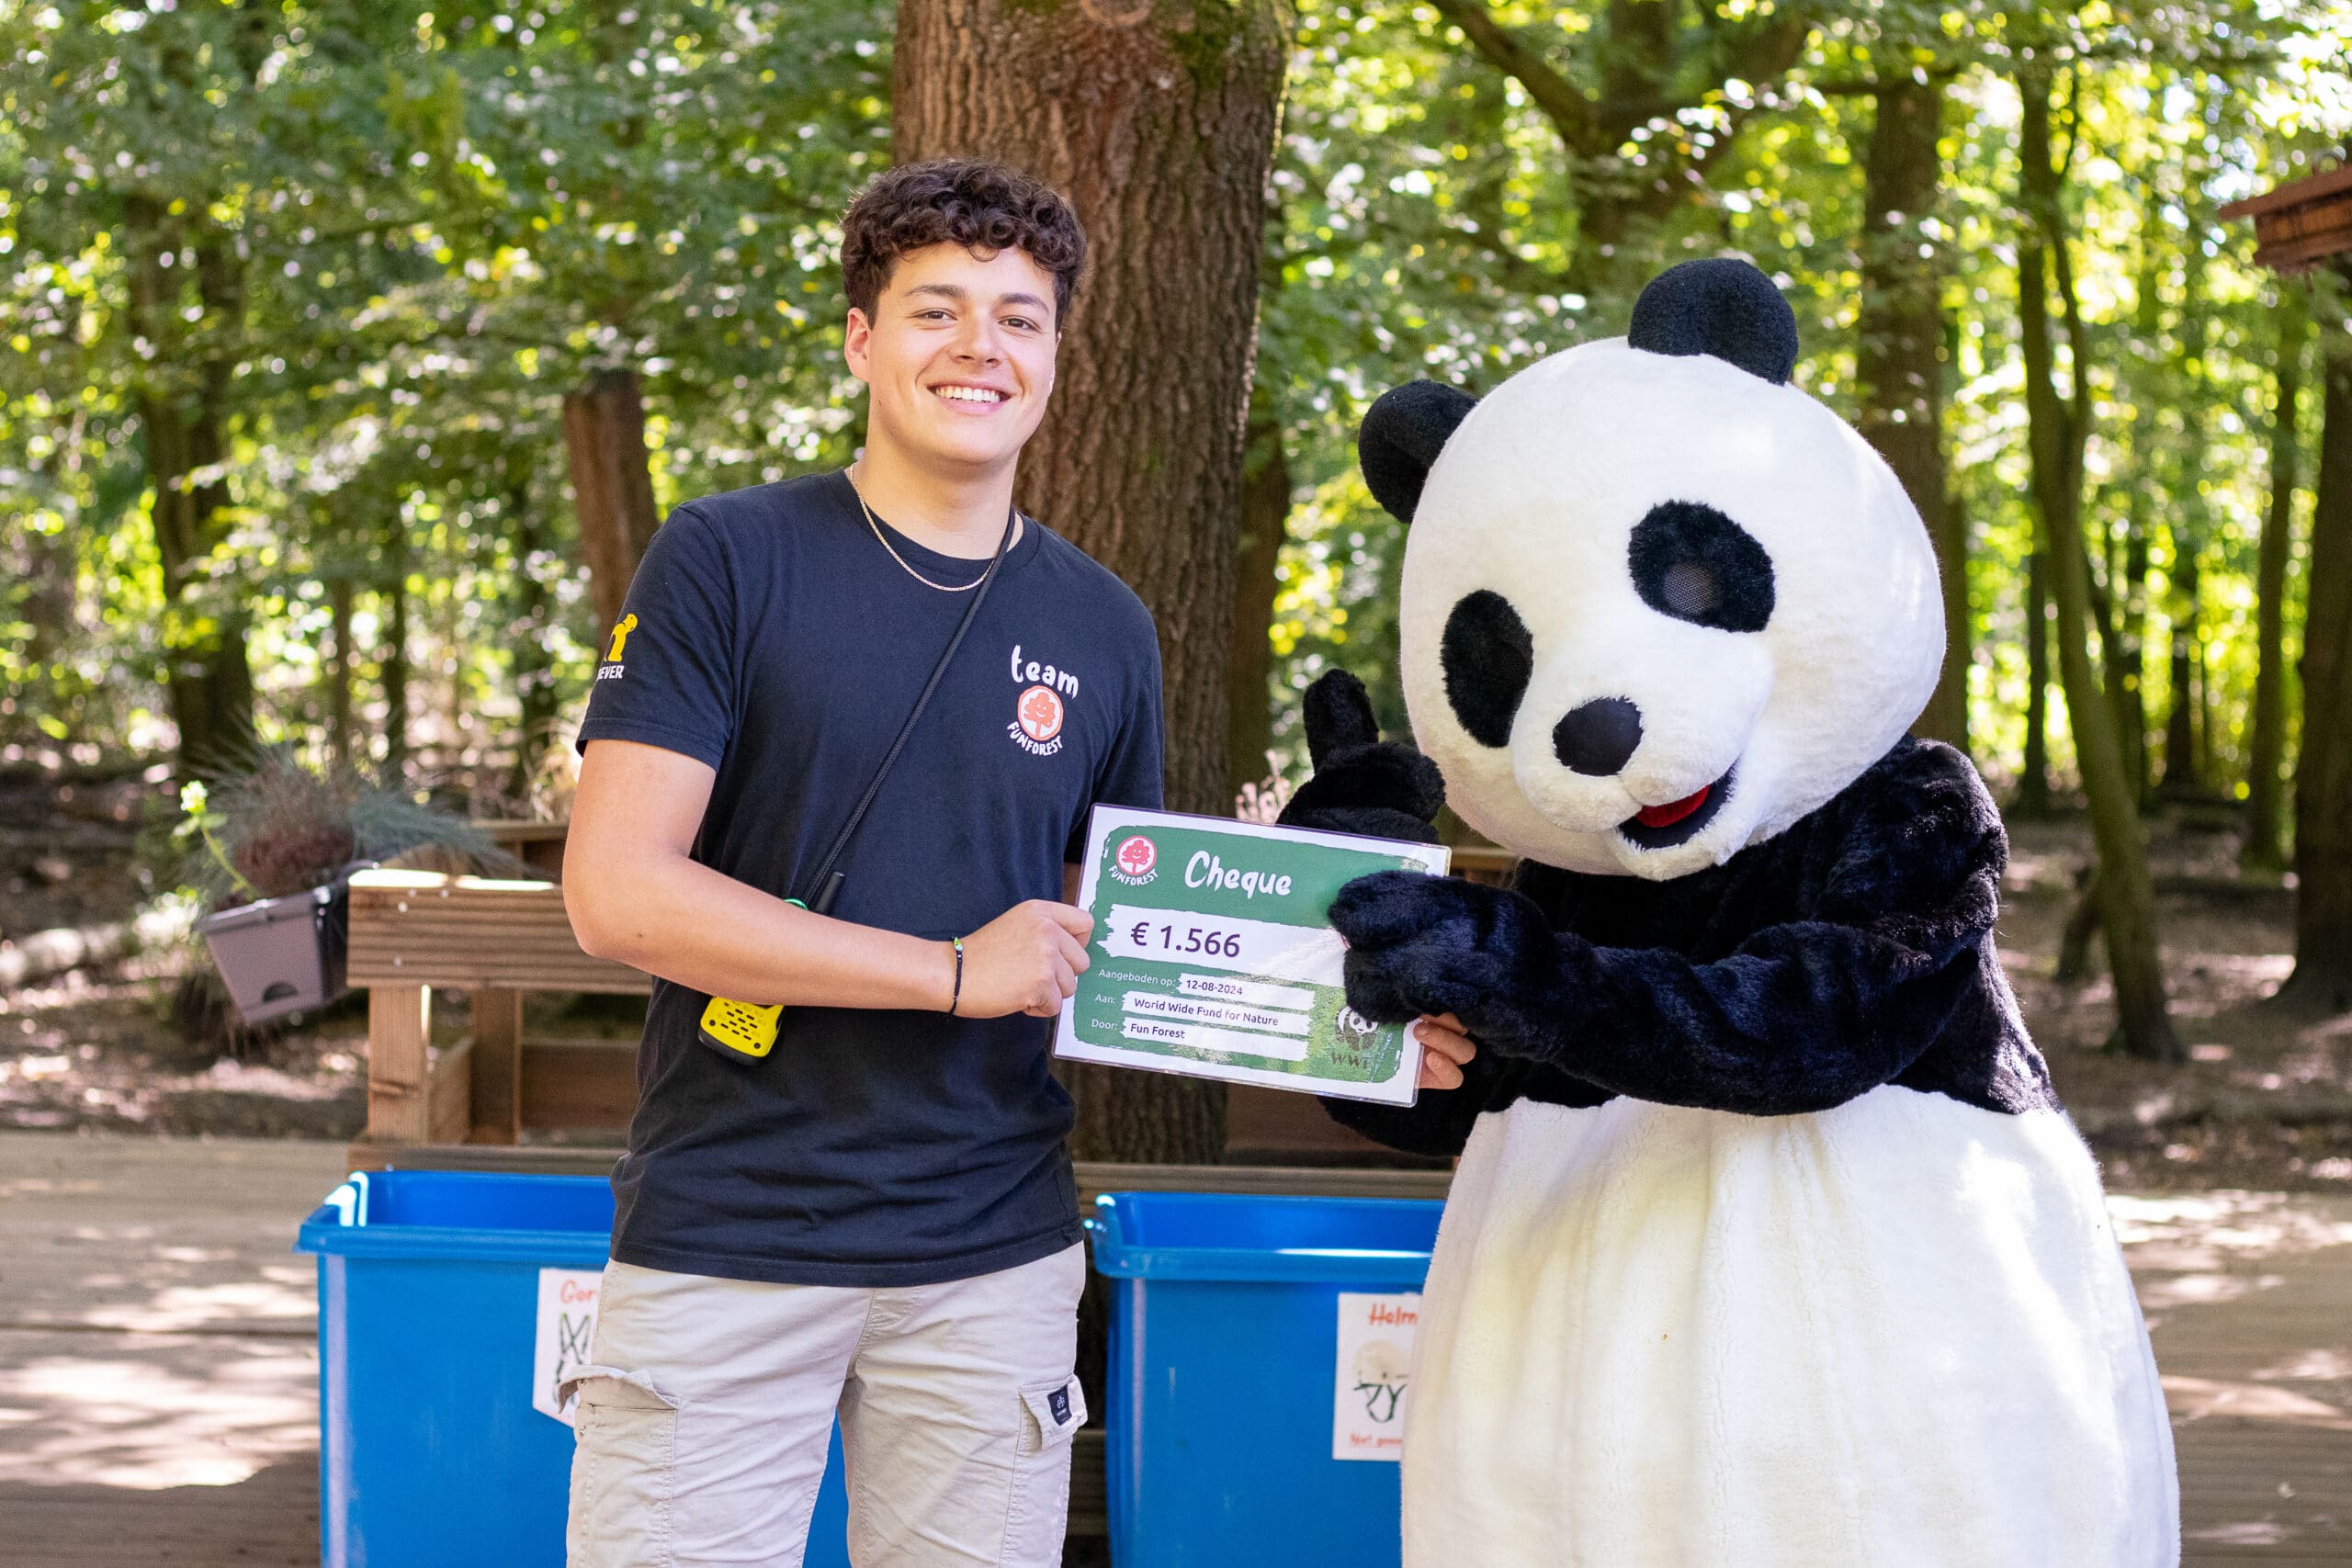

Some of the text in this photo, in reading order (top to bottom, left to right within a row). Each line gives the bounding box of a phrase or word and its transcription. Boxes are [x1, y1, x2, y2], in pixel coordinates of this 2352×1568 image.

[597, 664, 625, 681] EVER
[1012, 644, 1079, 699] team
[1006, 721, 1063, 755] FUNFOREST
[1108, 864, 1159, 886] FUNFOREST
[1184, 850, 1292, 899] Cheque
[1131, 921, 1241, 958] € 1.566
[1098, 969, 1176, 987] Aangeboden op:
[1186, 979, 1243, 996] 12-08-2024
[1094, 993, 1116, 1004] Aan:
[1134, 998, 1279, 1026] World Wide Fund for Nature
[1091, 1019, 1118, 1031] Door:
[1130, 1023, 1186, 1039] Fun Forest
